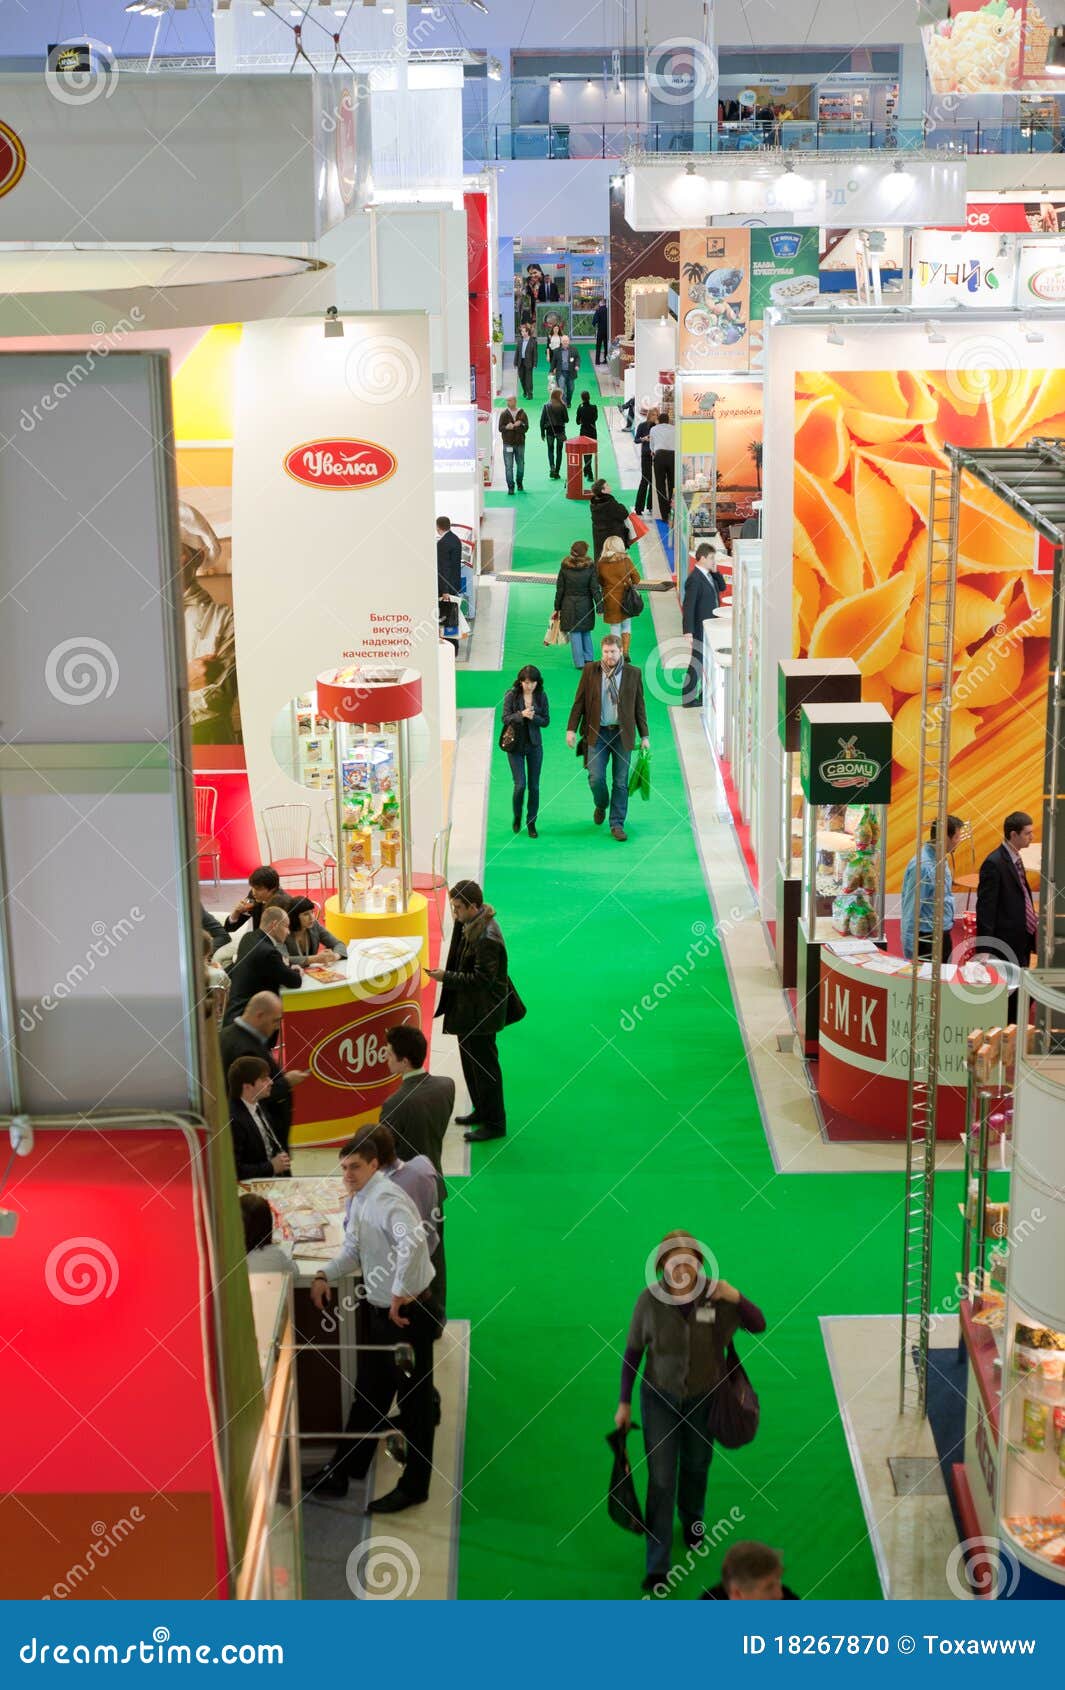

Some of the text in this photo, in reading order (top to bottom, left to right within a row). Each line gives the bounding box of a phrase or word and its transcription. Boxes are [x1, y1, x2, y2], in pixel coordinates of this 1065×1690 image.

[919, 259, 999, 293] ТУНИС
[302, 450, 378, 477] Увелка
[370, 613, 412, 623] Быстро,
[373, 626, 412, 635] вкусно,
[362, 639, 412, 647] надежно,
[343, 650, 410, 658] качественно
